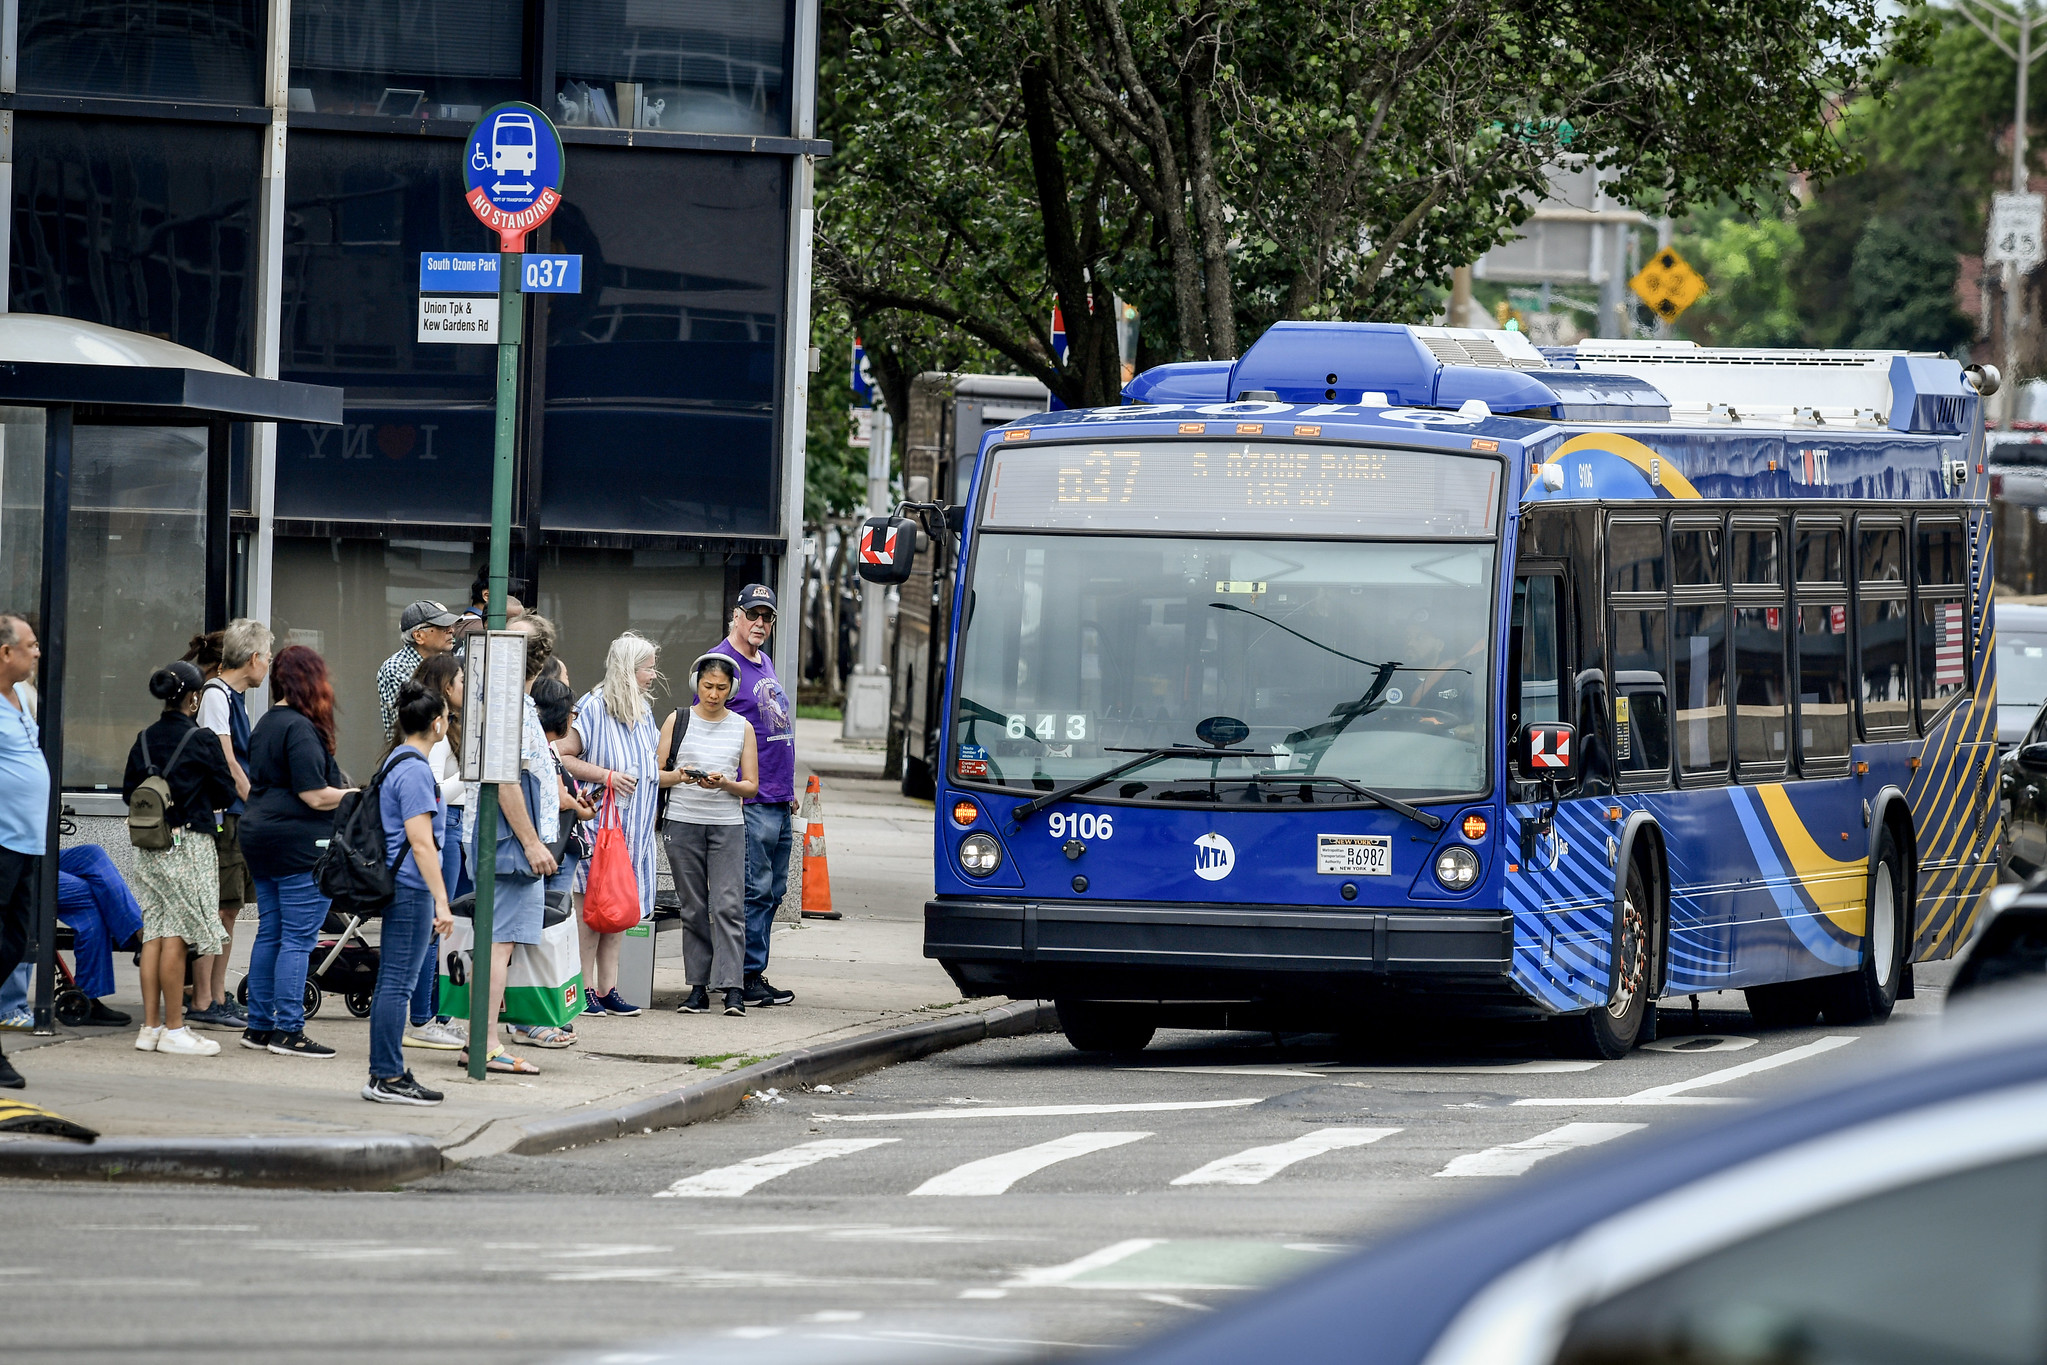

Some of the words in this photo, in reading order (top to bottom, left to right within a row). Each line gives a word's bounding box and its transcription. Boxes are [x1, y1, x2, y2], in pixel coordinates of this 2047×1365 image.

[472, 194, 492, 217] NO
[491, 191, 555, 229] STANDING
[427, 257, 451, 271] South
[452, 258, 476, 272] Ozone
[478, 259, 497, 272] Park
[526, 259, 569, 288] Q37
[424, 302, 447, 314] Union
[449, 302, 464, 316] Tpk
[466, 302, 472, 314] &
[423, 319, 441, 331] Kew
[442, 319, 476, 332] Gardens
[478, 320, 489, 332] Rd
[1578, 463, 1593, 488] 9106
[1799, 449, 1806, 486] I
[1812, 449, 1828, 487] NY
[1048, 811, 1114, 840] 9106
[1194, 843, 1228, 870] MTA
[1355, 848, 1384, 866] 6982
[1559, 838, 1569, 855] Bus
